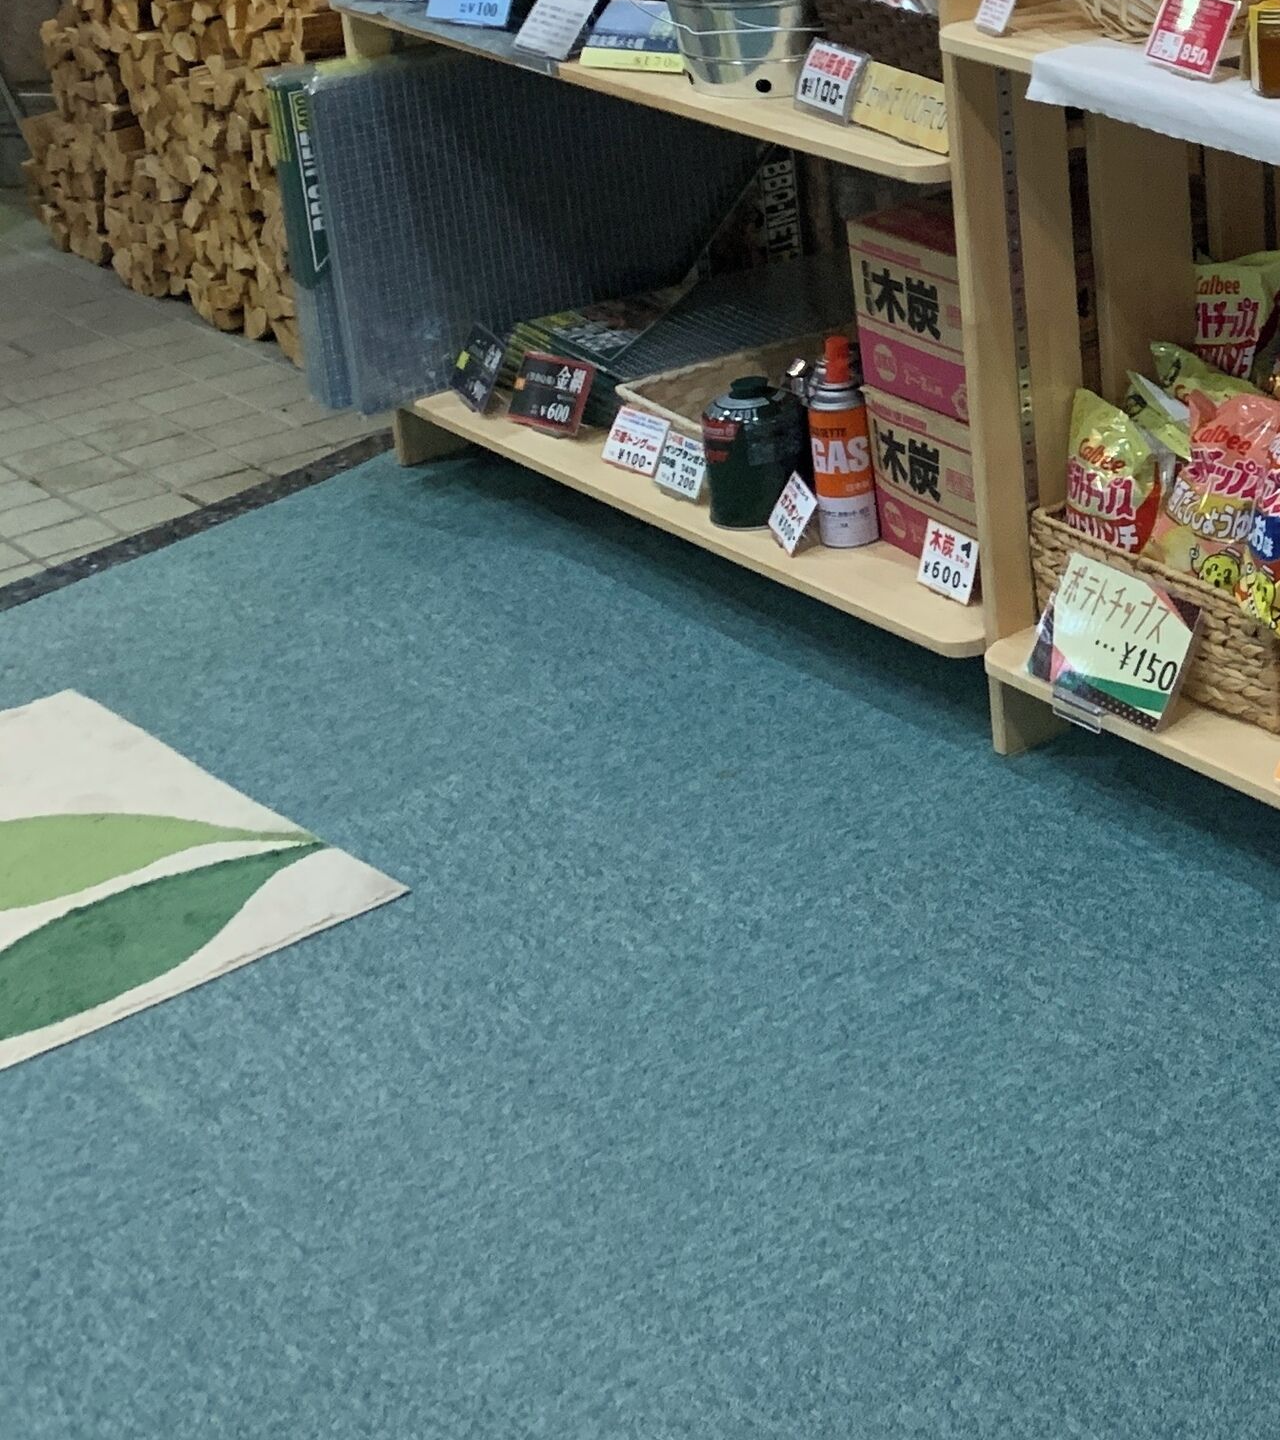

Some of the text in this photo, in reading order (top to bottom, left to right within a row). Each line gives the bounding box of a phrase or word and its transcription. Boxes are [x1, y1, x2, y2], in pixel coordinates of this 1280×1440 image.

[872, 268, 941, 341] 木炭
[812, 436, 870, 474] GAS
[879, 429, 942, 503] 木炭
[1060, 565, 1174, 644] ポテトチップス
